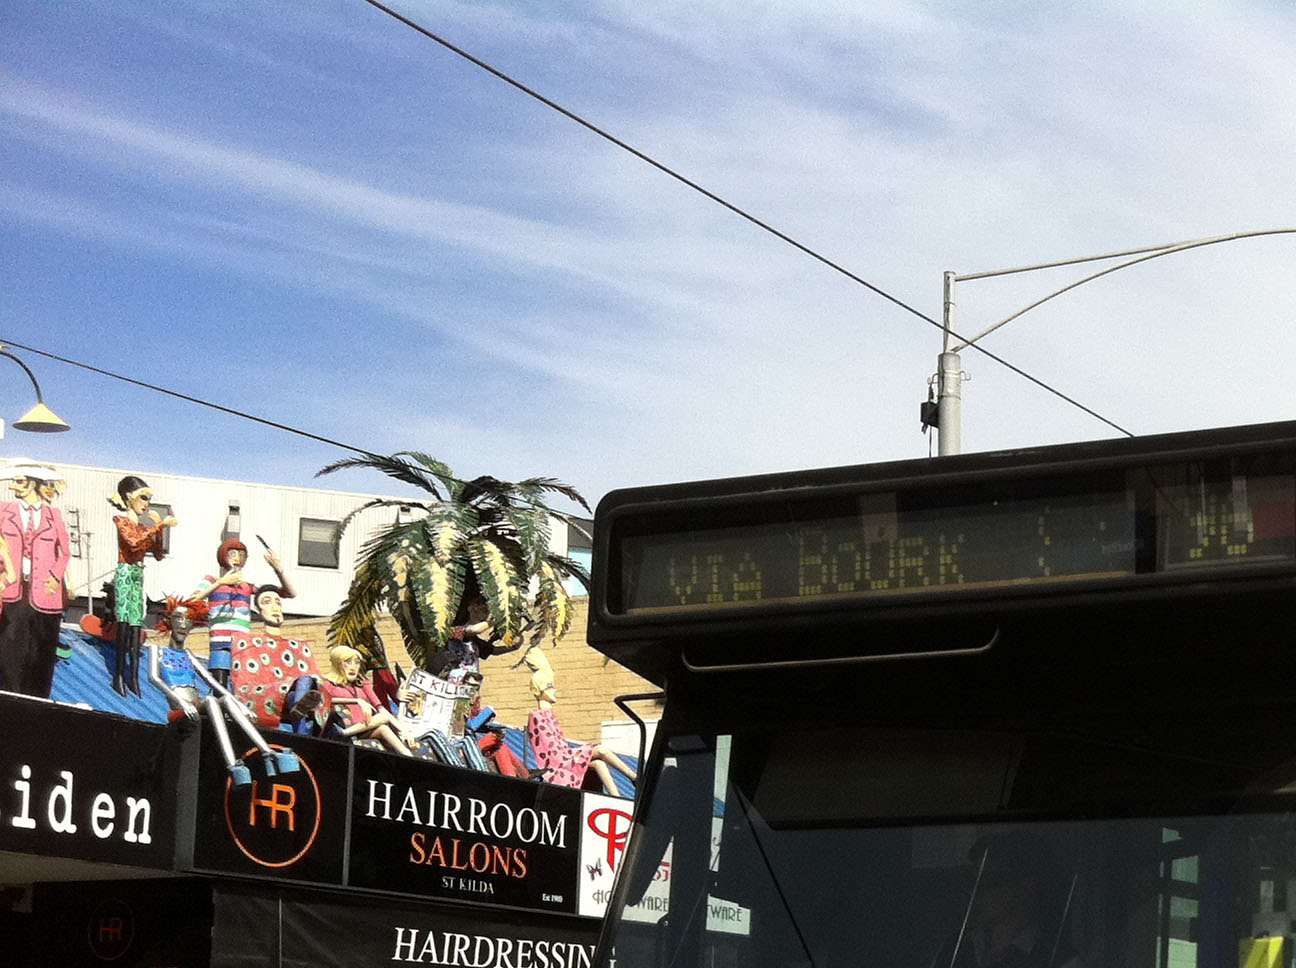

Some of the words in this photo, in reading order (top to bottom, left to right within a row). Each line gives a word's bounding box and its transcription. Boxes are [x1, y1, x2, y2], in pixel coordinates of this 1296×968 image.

[365, 778, 569, 849] HAIRROOM
[409, 831, 529, 879] SALONS
[441, 875, 456, 890] ST
[459, 876, 495, 895] KILDA
